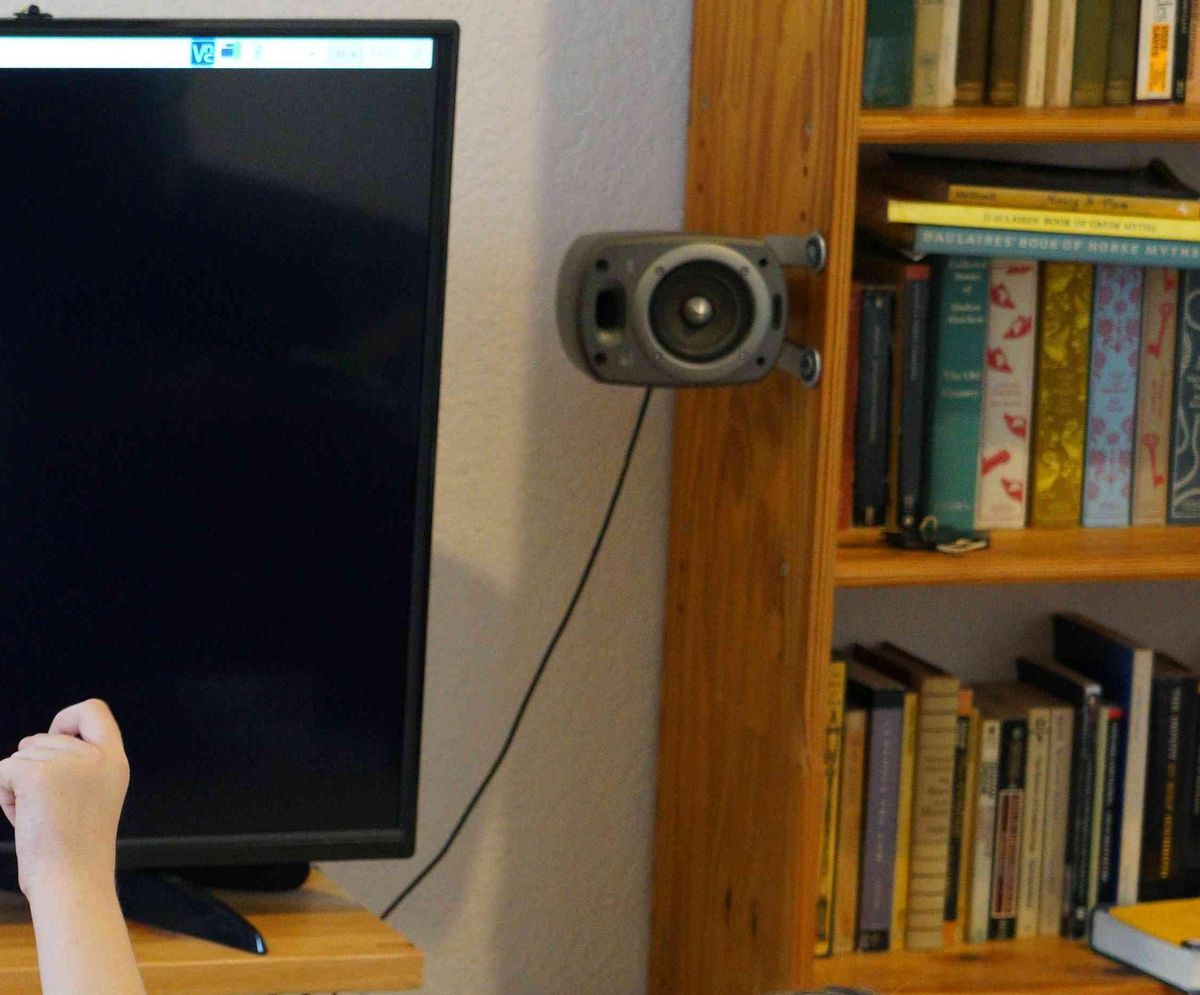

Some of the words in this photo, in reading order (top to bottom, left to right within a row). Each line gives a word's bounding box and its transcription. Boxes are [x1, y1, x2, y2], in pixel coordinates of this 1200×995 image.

[1019, 237, 1058, 250] BOOK
[1062, 239, 1083, 252] OF
[1087, 241, 1140, 256] NORSE
